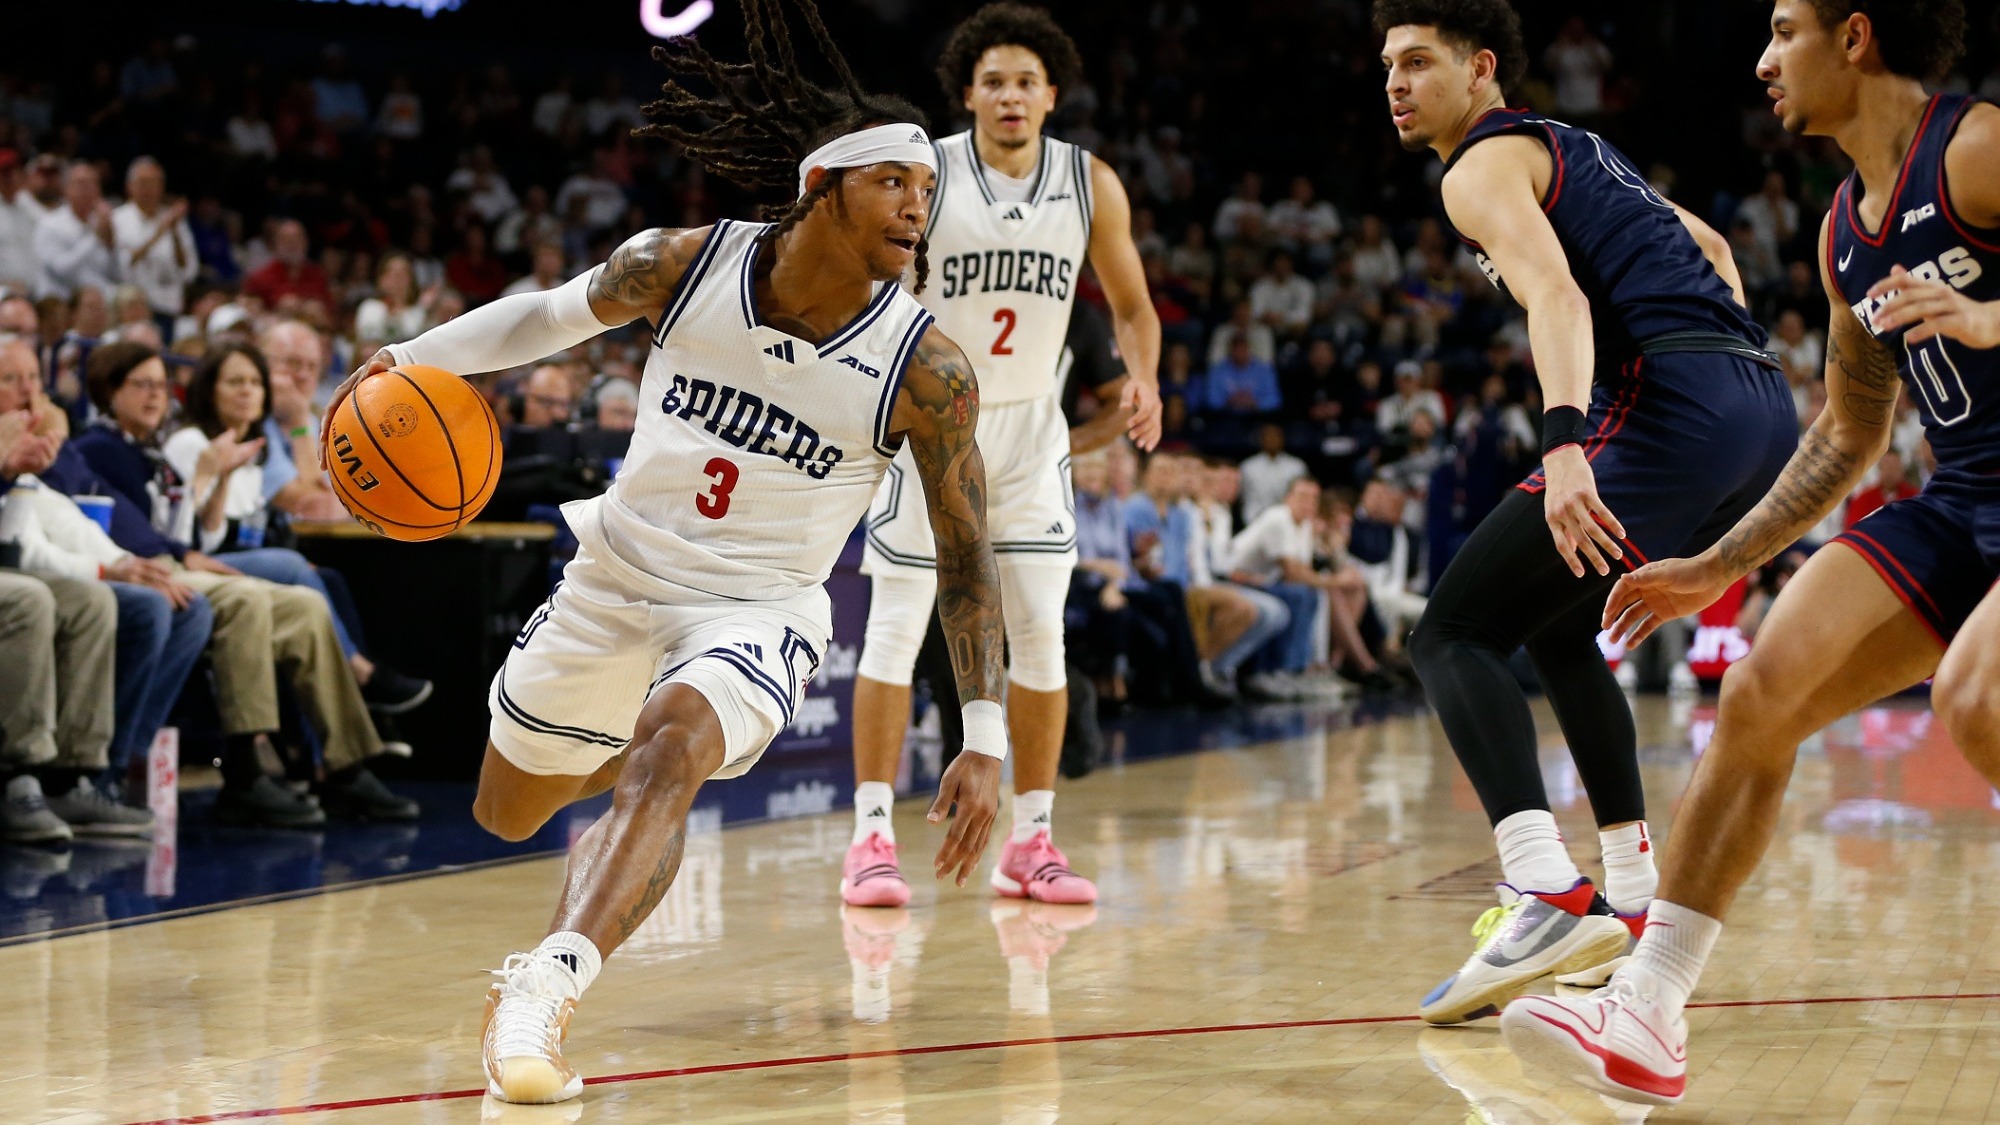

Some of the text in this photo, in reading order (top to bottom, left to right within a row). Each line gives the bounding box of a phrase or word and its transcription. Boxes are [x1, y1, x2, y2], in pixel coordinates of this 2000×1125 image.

[942, 249, 1072, 301] SPIDERS
[990, 308, 1017, 356] 2
[836, 354, 880, 379] A10
[661, 374, 844, 480] SPIDERS
[333, 433, 380, 492] EVO
[695, 457, 740, 520] 3
